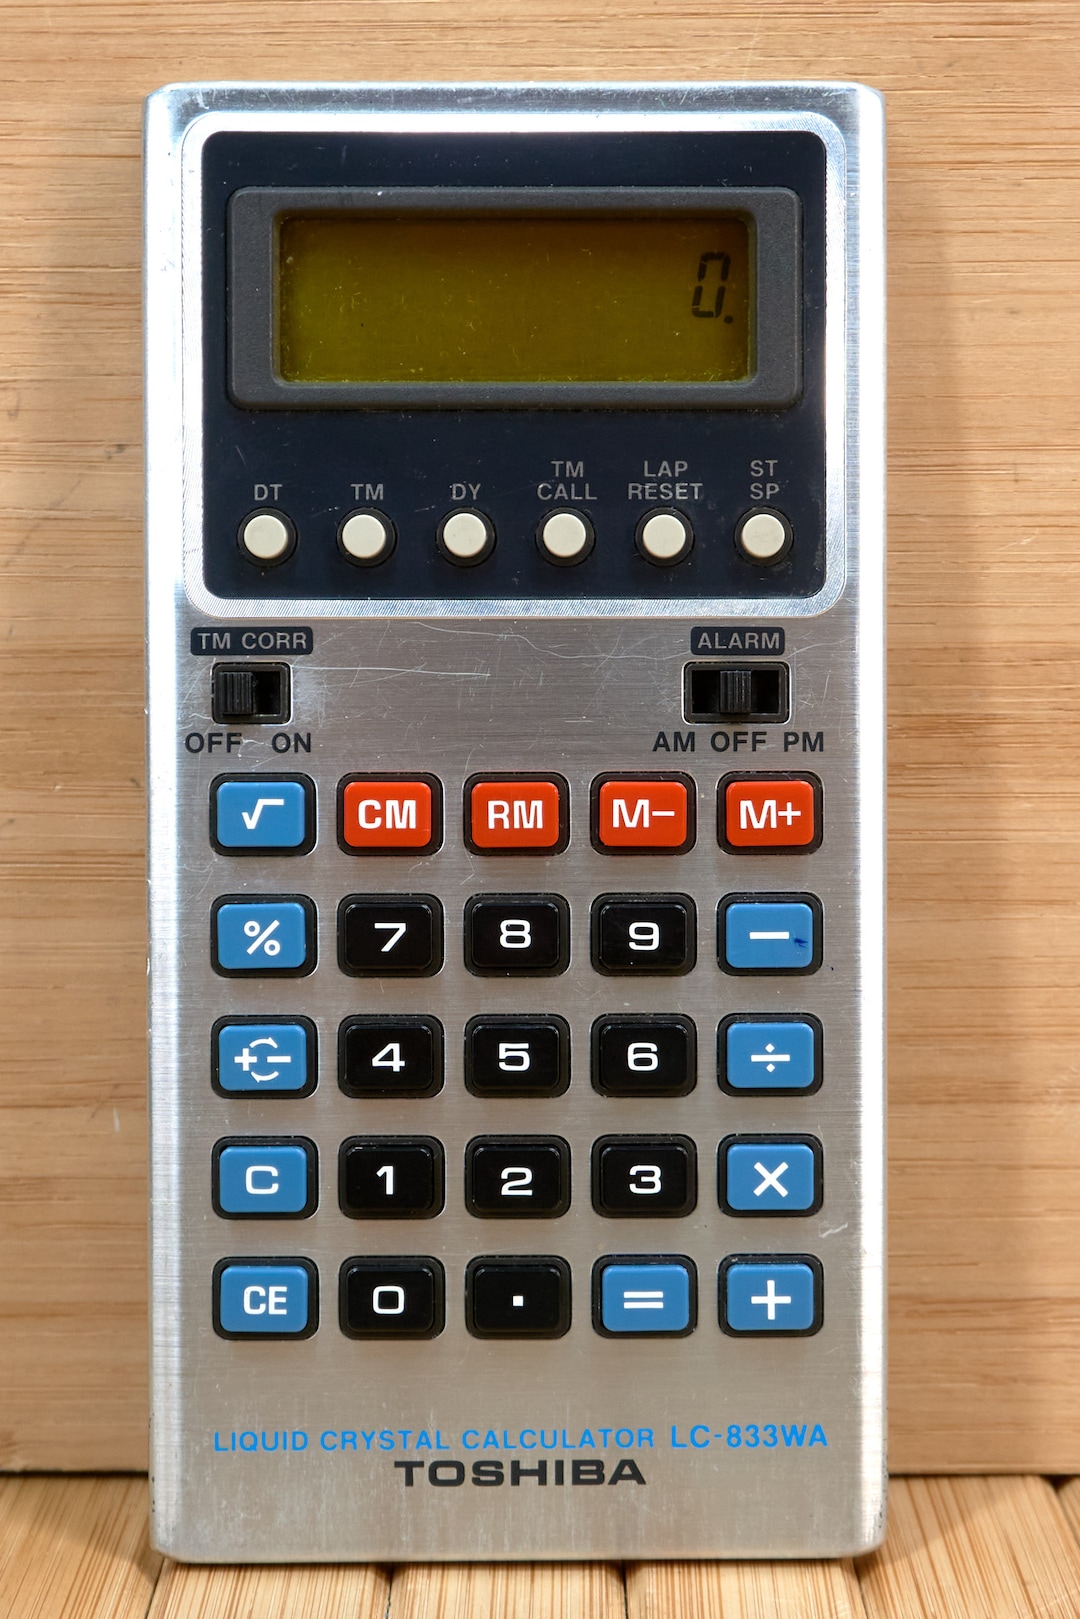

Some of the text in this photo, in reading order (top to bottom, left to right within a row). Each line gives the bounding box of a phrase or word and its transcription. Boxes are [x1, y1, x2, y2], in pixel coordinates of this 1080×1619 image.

[550, 460, 584, 479] TM
[643, 460, 688, 478] LAP
[749, 459, 778, 478] ST
[253, 484, 283, 502] DT
[350, 483, 384, 501] TM
[451, 483, 482, 501] DY
[536, 483, 598, 501] CALL
[627, 483, 704, 501] RESET
[749, 482, 781, 500] SP
[197, 632, 308, 651] TM CORR
[697, 632, 781, 650] ALARM
[184, 732, 243, 755] OFF
[270, 731, 312, 754] ON
[652, 731, 696, 753] AM
[710, 731, 767, 753] OFF
[783, 731, 825, 753] PM
[356, 800, 417, 830] CM
[486, 800, 544, 830] RM
[738, 800, 802, 829] M+
[242, 919, 281, 956] %
[373, 922, 407, 953] 7
[499, 920, 532, 950] 8
[628, 921, 660, 952] 9
[371, 1043, 406, 1072] 4
[498, 1042, 530, 1072] 5
[626, 1042, 659, 1072] 6
[244, 1164, 280, 1196] C
[376, 1165, 395, 1196] 1
[500, 1167, 533, 1197] 2
[628, 1165, 662, 1195] 3
[242, 1285, 288, 1316] CE
[372, 1285, 405, 1315] 0
[750, 1279, 792, 1321] +
[214, 1424, 829, 1452] LIQUID CRYSTAL CALCULATOR LC-833WA
[393, 1459, 646, 1487] TOSHIBA
